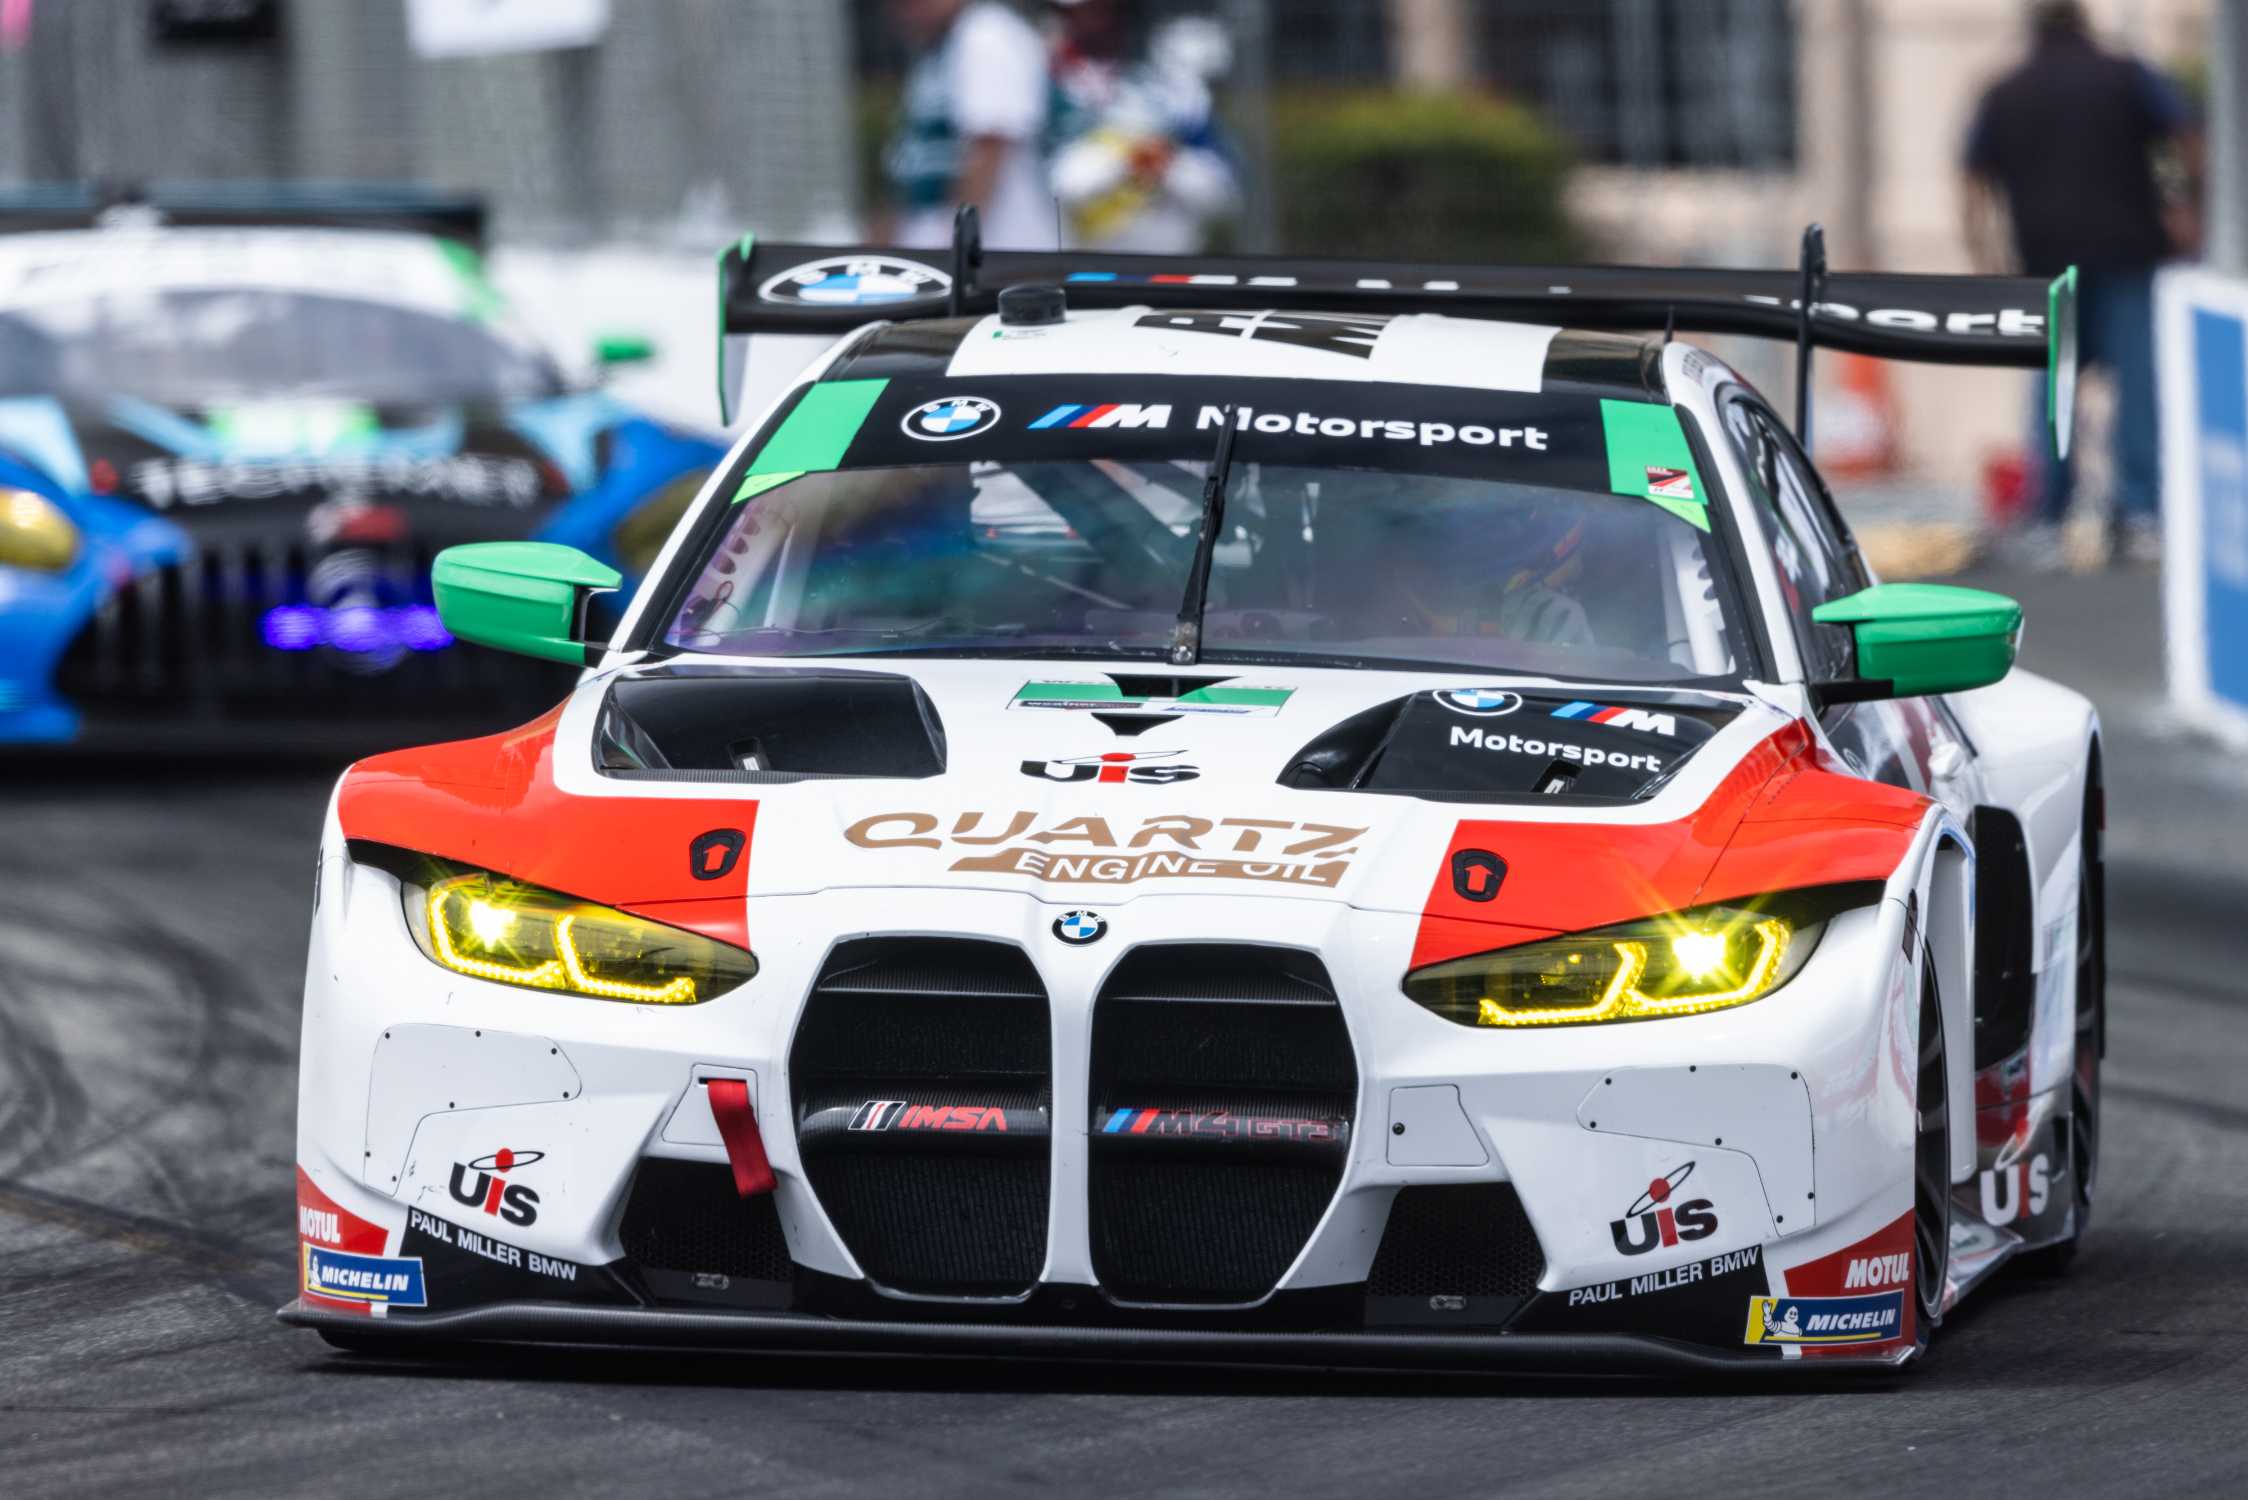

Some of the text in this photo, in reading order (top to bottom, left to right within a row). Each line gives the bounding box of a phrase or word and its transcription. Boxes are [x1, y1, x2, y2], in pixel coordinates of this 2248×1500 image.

[1196, 403, 1549, 451] Motorsport
[1449, 726, 1662, 773] Motorsport
[843, 811, 1370, 859] QUARTZ
[1014, 851, 1218, 880] ENGINE
[898, 1105, 1008, 1131] IMSA
[300, 1205, 341, 1244] MOTUL
[410, 1211, 577, 1281] PAUL MILLER BMW
[321, 1265, 410, 1291] MICHELIN
[1569, 1246, 1760, 1306] PAUL MILLER BMW
[1844, 1251, 1910, 1289] MOTUL
[1806, 1308, 1896, 1332] MICHELIN
